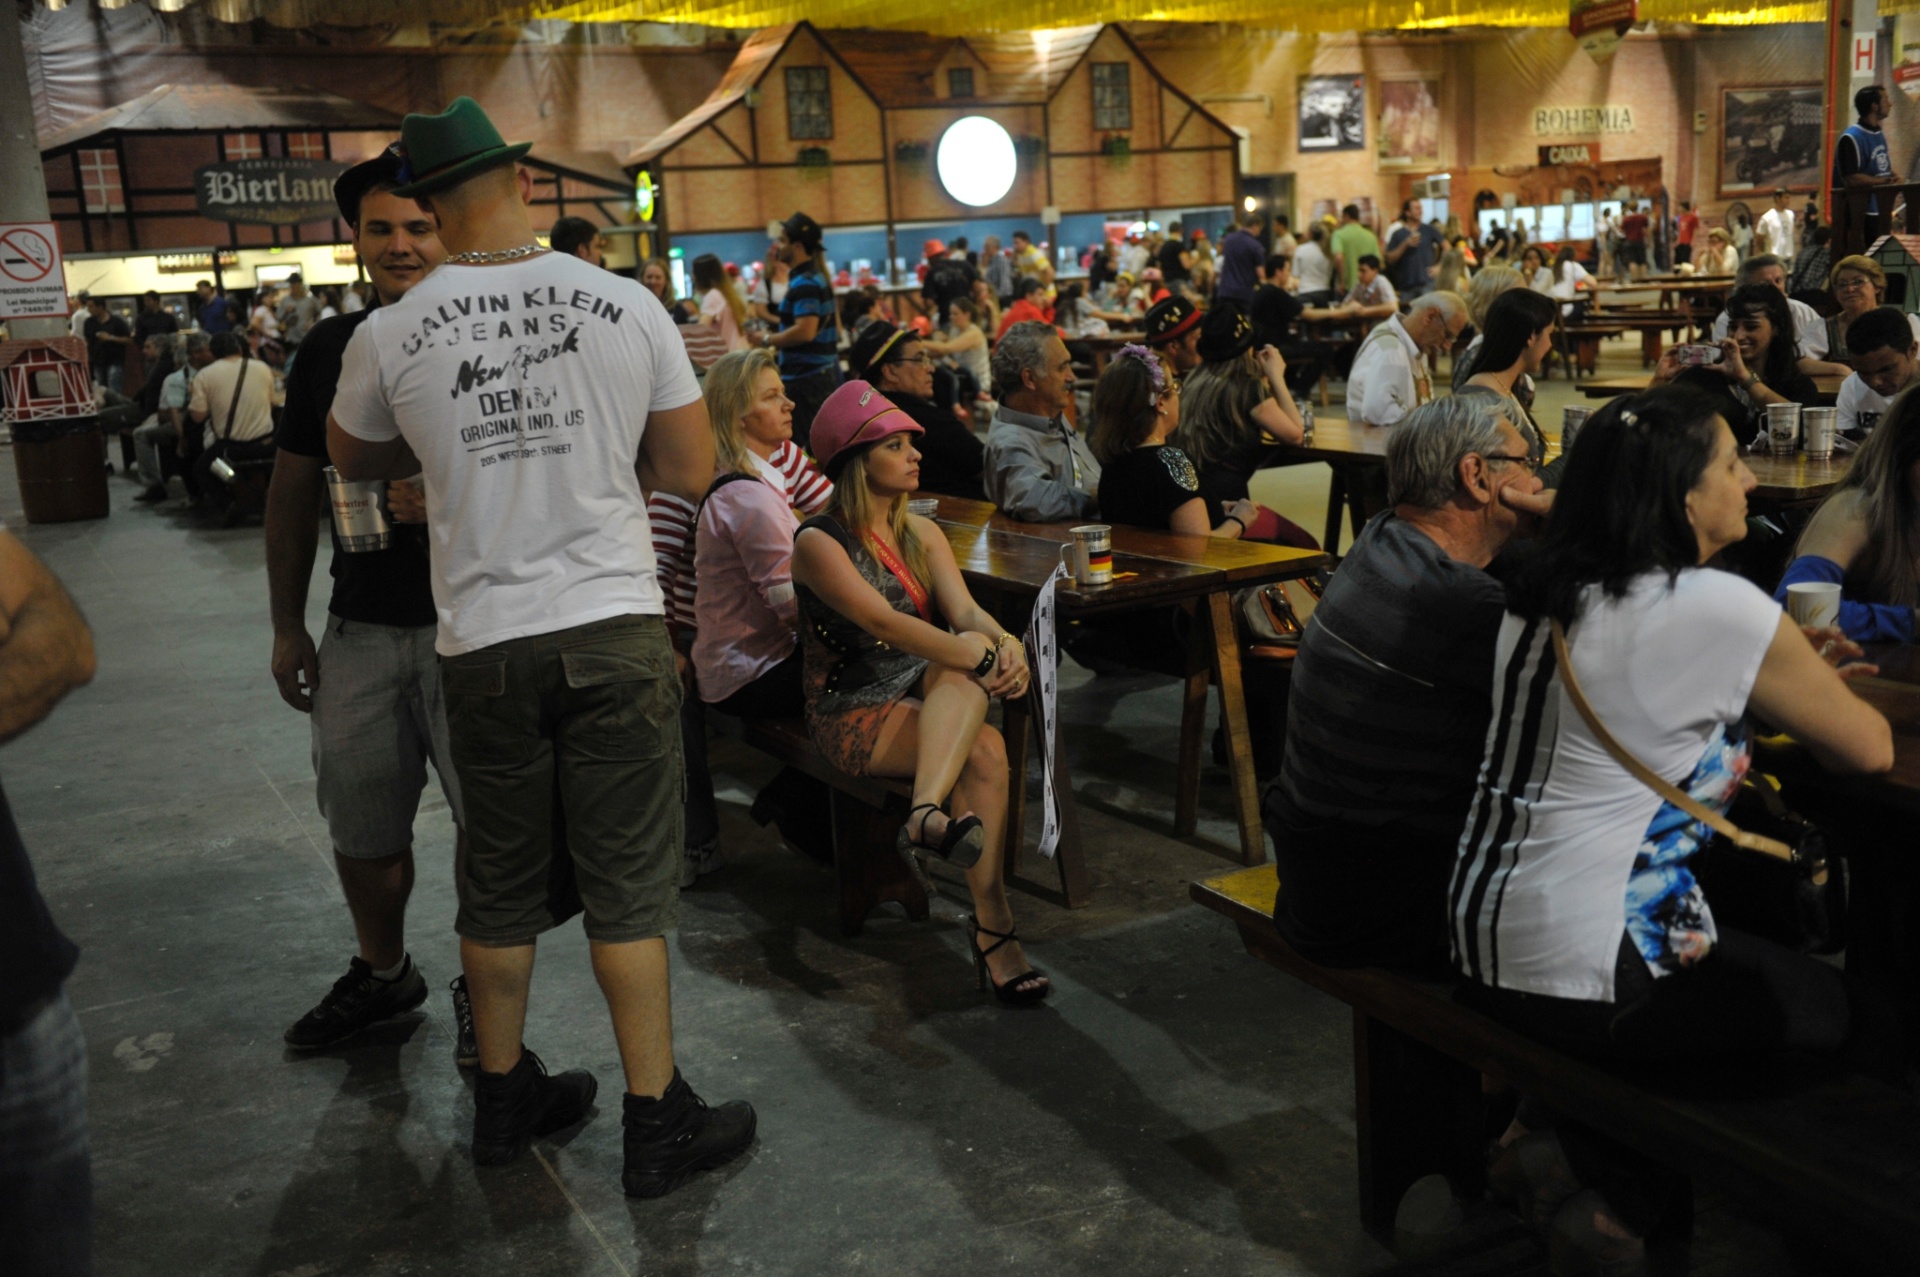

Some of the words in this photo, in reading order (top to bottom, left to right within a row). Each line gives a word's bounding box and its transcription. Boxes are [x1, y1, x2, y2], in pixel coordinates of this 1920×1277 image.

[1855, 38, 1874, 70] H
[1534, 105, 1634, 132] BOHEMIA
[1548, 145, 1591, 164] CAIXA
[20, 297, 57, 305] Municipal
[402, 294, 510, 356] CALVIN
[523, 286, 624, 325] KLEIN
[451, 354, 509, 399] New
[460, 417, 523, 443] ORIGINAL
[564, 409, 585, 426] US
[480, 454, 497, 467] 205
[541, 443, 572, 456] STREET
